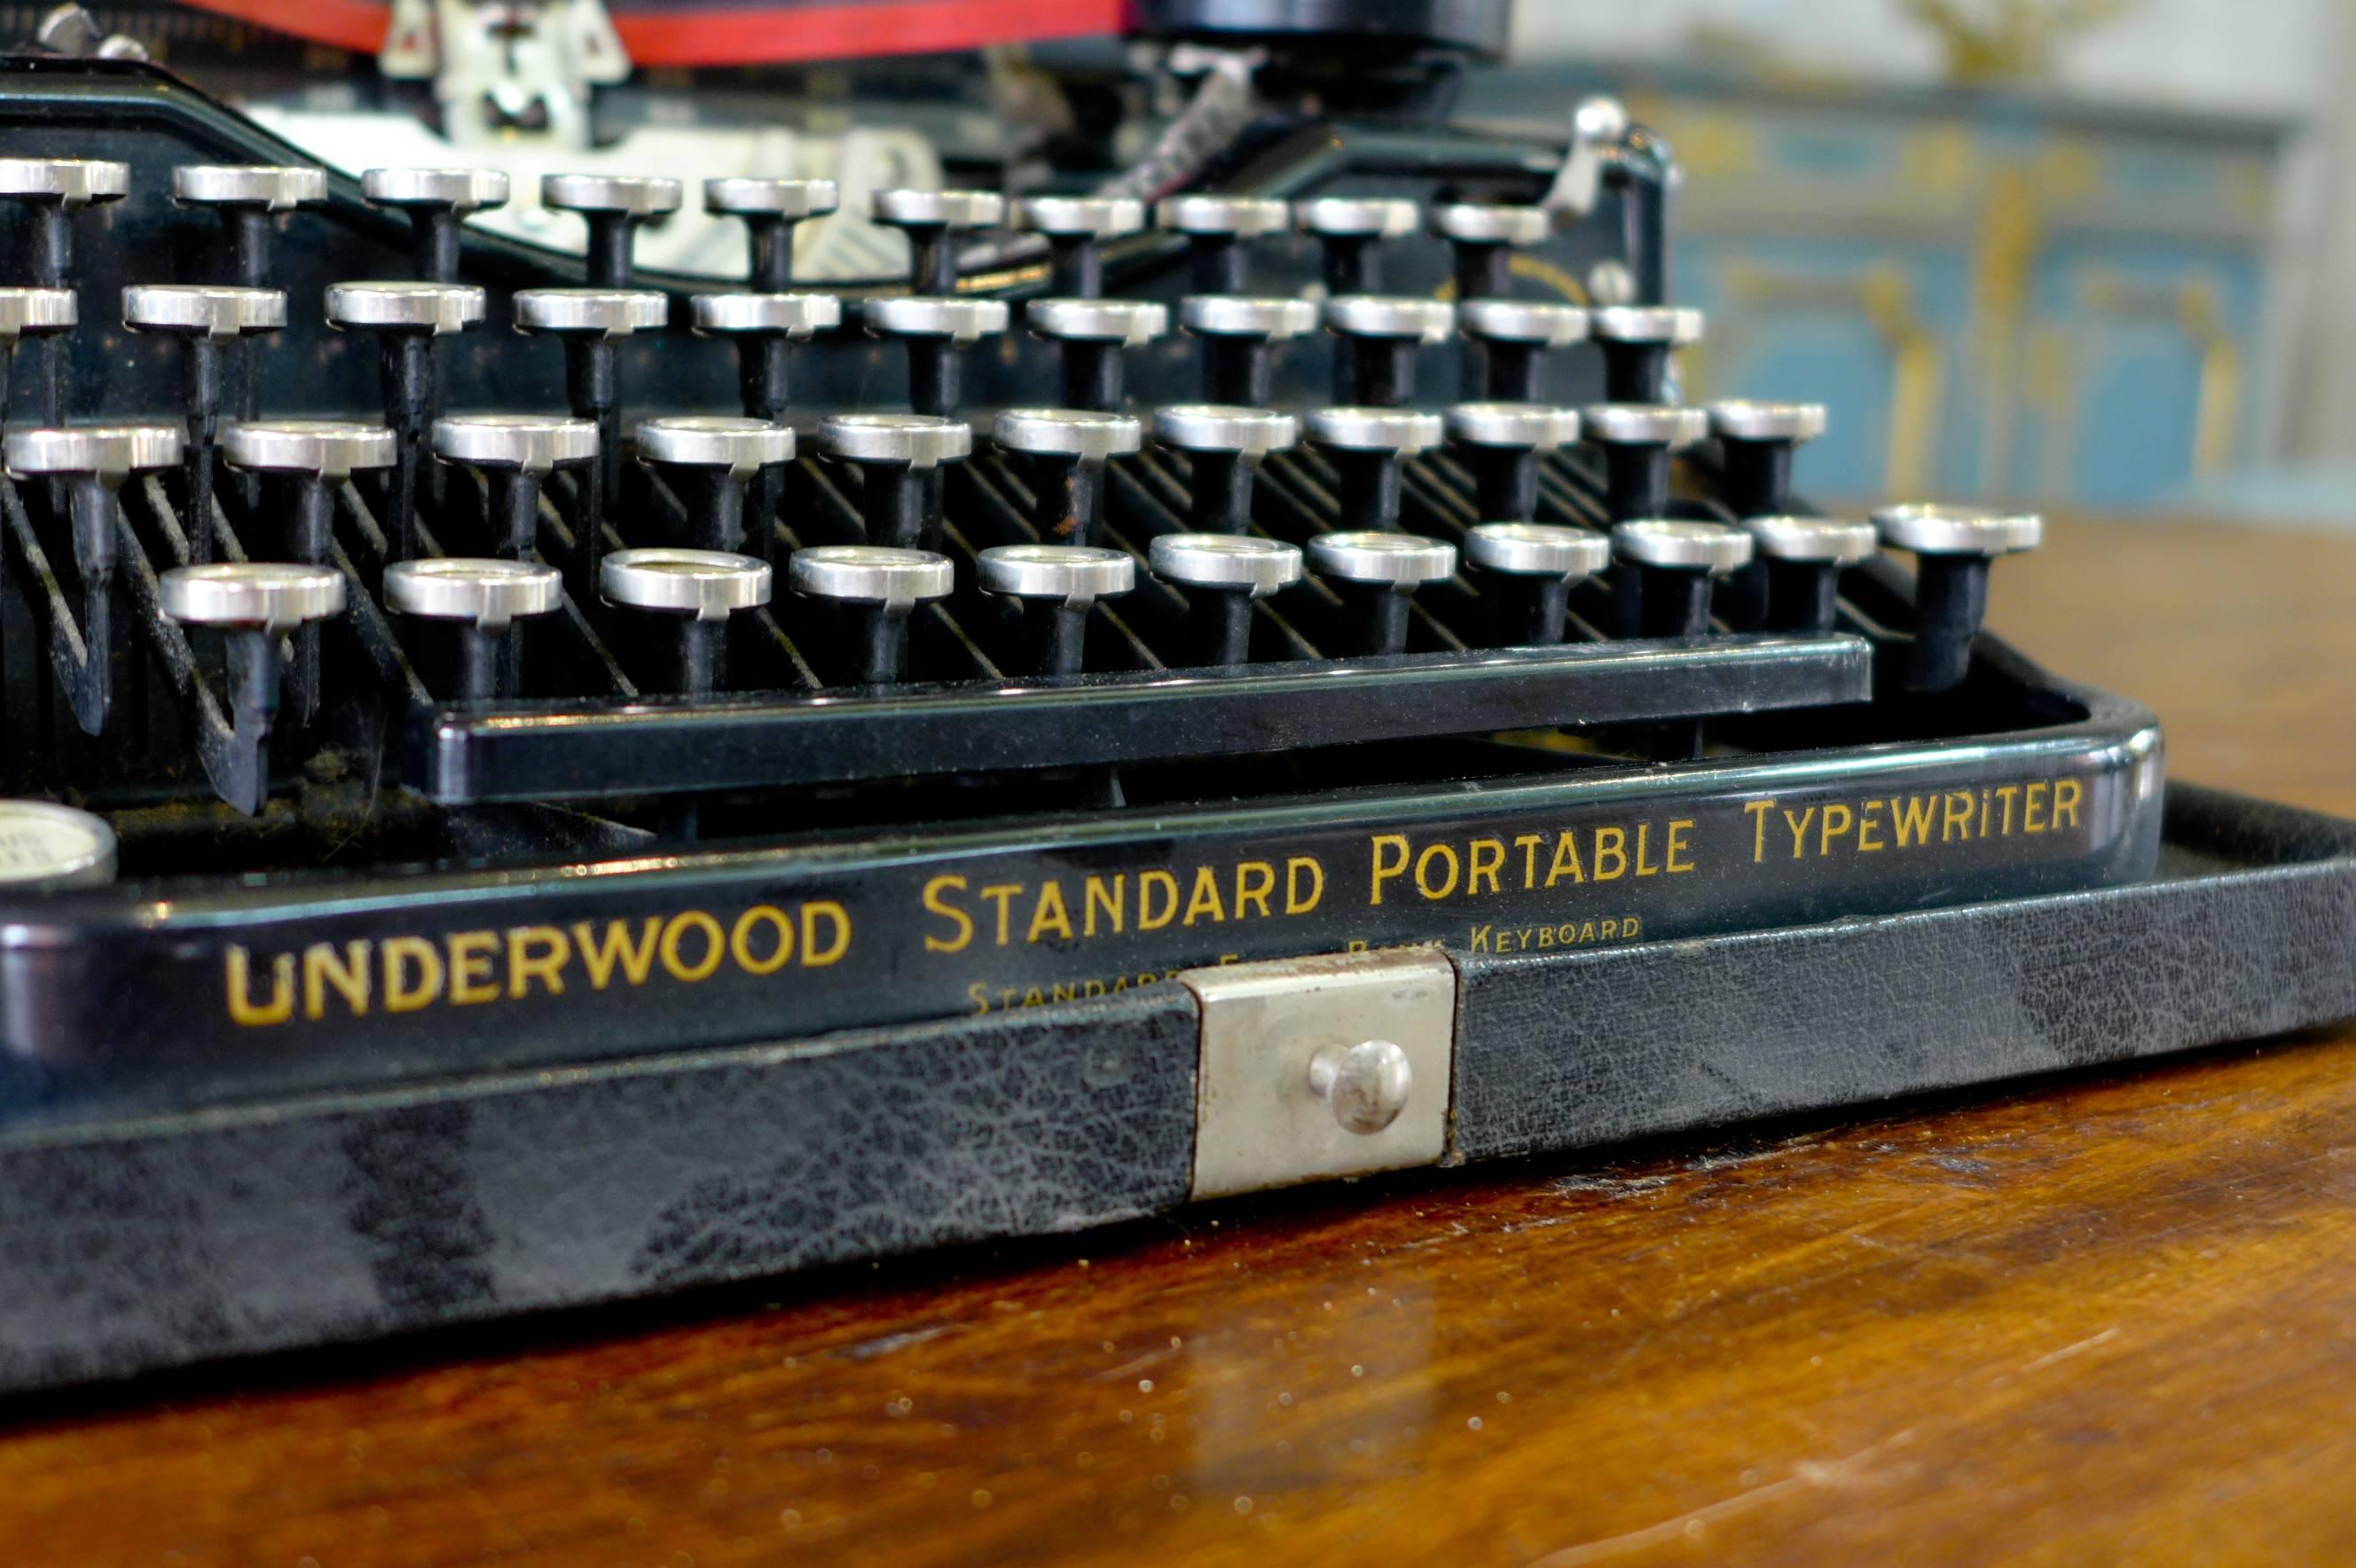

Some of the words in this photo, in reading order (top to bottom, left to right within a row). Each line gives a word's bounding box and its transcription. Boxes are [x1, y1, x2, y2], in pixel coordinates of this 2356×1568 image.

[225, 900, 852, 1026] UNDERWOOD
[922, 861, 1325, 953] STANDARD
[1369, 818, 1698, 906] PORTABLE
[1744, 780, 2083, 863] TYPEWRITER
[1470, 917, 1641, 955] KEYBOARD
